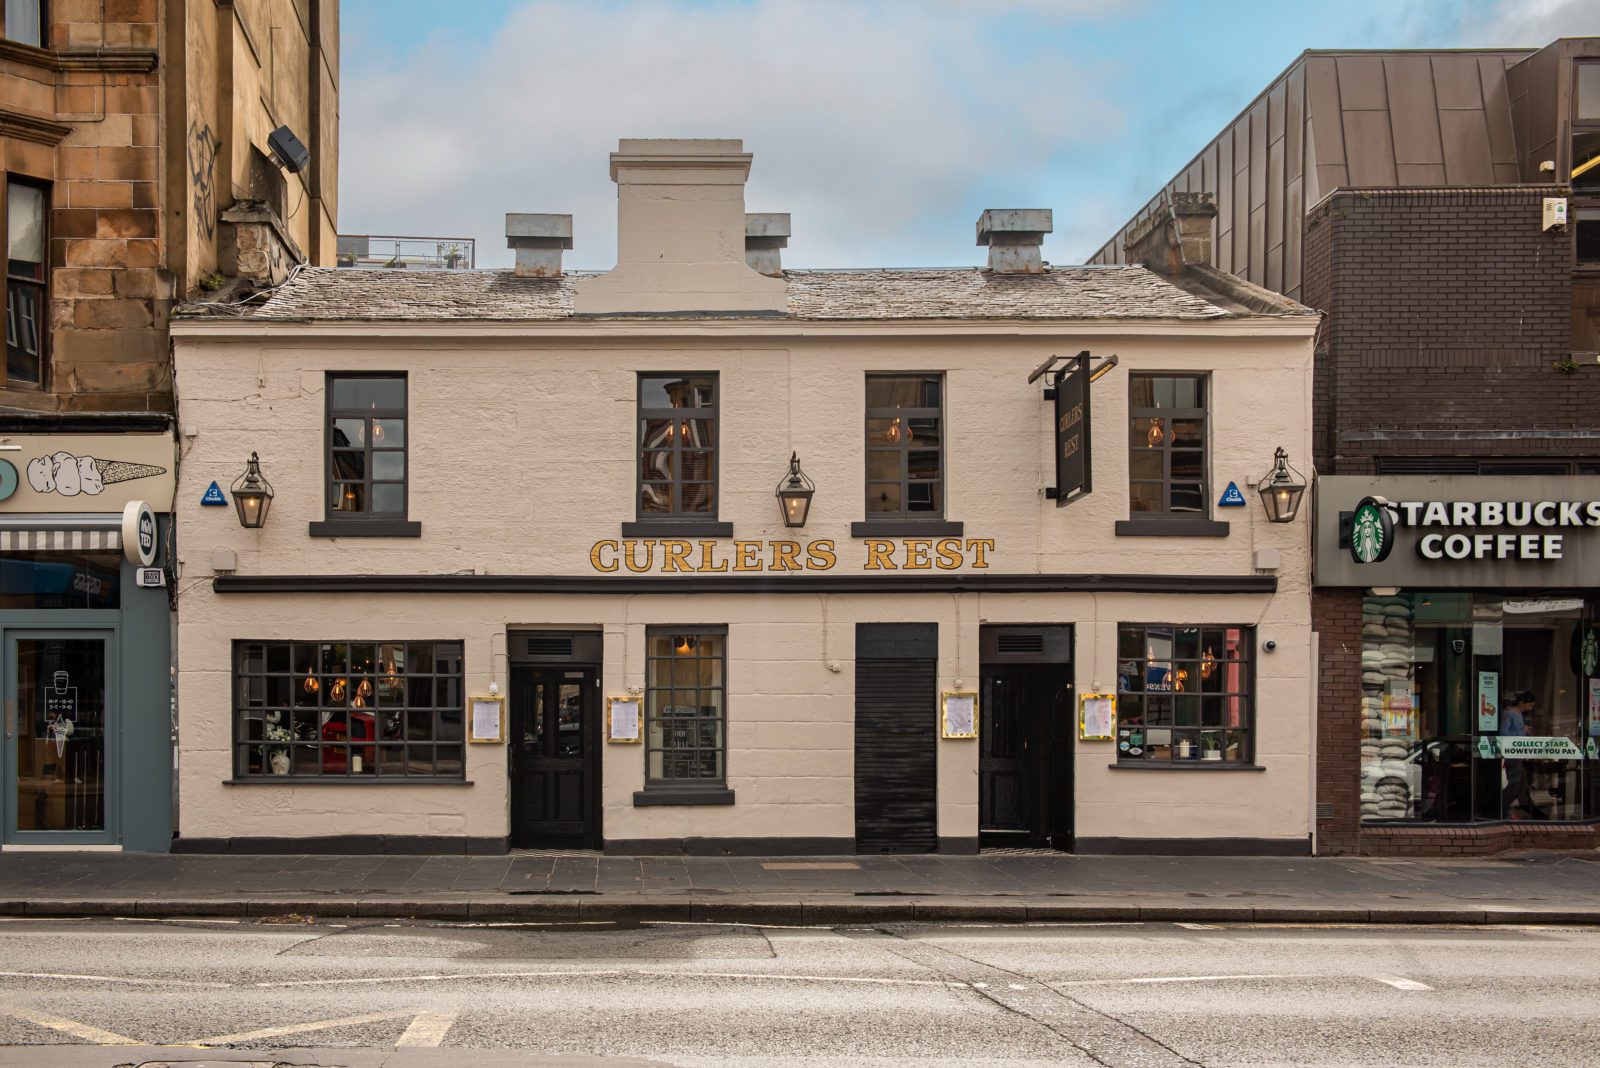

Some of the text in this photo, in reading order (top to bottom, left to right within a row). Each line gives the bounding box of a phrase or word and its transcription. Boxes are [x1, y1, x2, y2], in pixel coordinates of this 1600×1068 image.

[1059, 403, 1083, 433] CURLERS
[1064, 434, 1079, 458] REST
[589, 538, 995, 573] CURLERS REST
[1420, 533, 1563, 559] COFFEE
